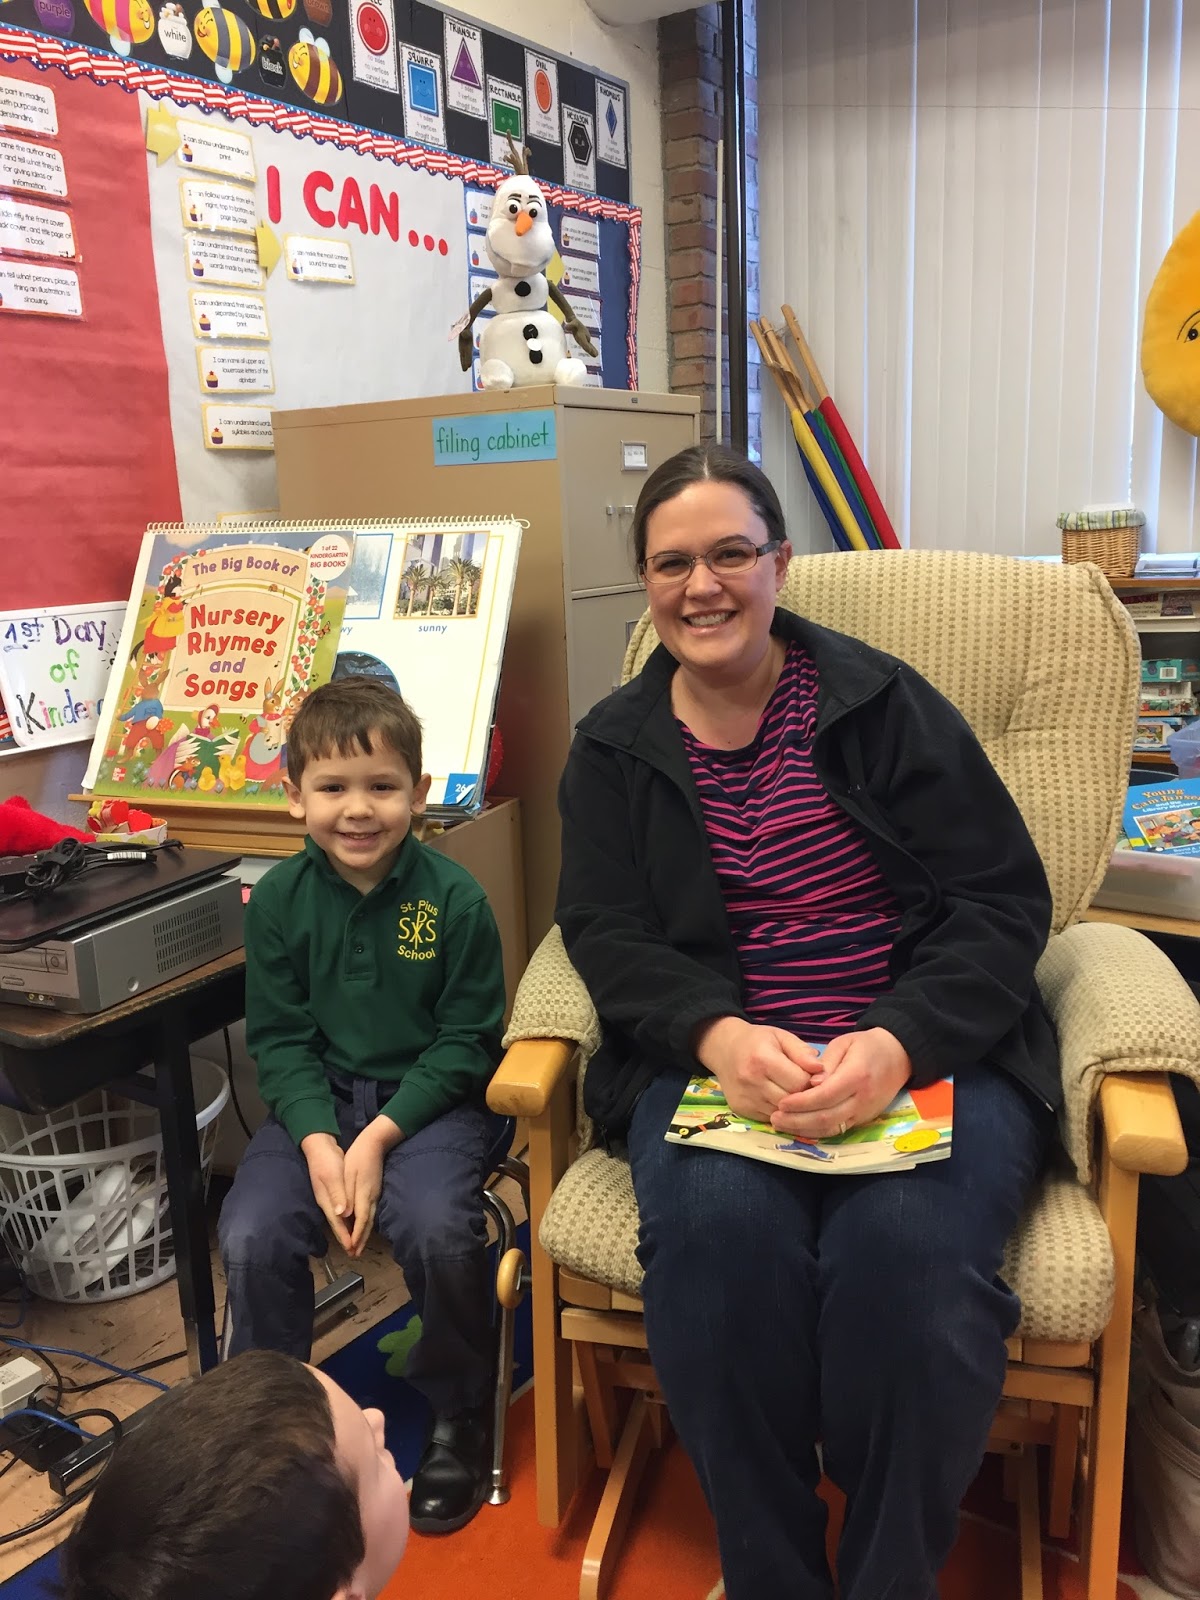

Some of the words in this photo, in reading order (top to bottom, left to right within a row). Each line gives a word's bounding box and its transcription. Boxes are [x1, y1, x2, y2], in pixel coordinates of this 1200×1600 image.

[39, 1, 71, 17] purple
[163, 27, 188, 43] white
[449, 22, 477, 41] TRIANGLE
[262, 57, 284, 75] black
[407, 52, 434, 68] SQUARE
[536, 60, 548, 71] OVAL
[489, 85, 521, 102] RECTANGLE
[267, 165, 281, 224] I
[436, 427, 480, 461] filing
[487, 421, 550, 451] cabinet
[192, 562, 217, 576] The
[221, 557, 243, 572] Big
[246, 556, 280, 571] Book
[281, 565, 299, 576] of
[323, 560, 346, 568] BOOKS
[190, 604, 285, 635] Nursery
[5, 617, 44, 643] 1st
[52, 615, 107, 651] Day
[418, 625, 448, 635] sunny
[187, 631, 277, 657] Rhymes
[50, 649, 80, 683] of
[209, 658, 246, 674] and
[184, 673, 258, 702] Songs
[1142, 789, 1184, 798] Young
[1132, 799, 1159, 810] Cam
[1142, 805, 1168, 813] Library
[1169, 801, 1198, 809] Mystery
[400, 902, 415, 913] St.
[418, 900, 439, 916] Pius
[397, 945, 436, 960] School
